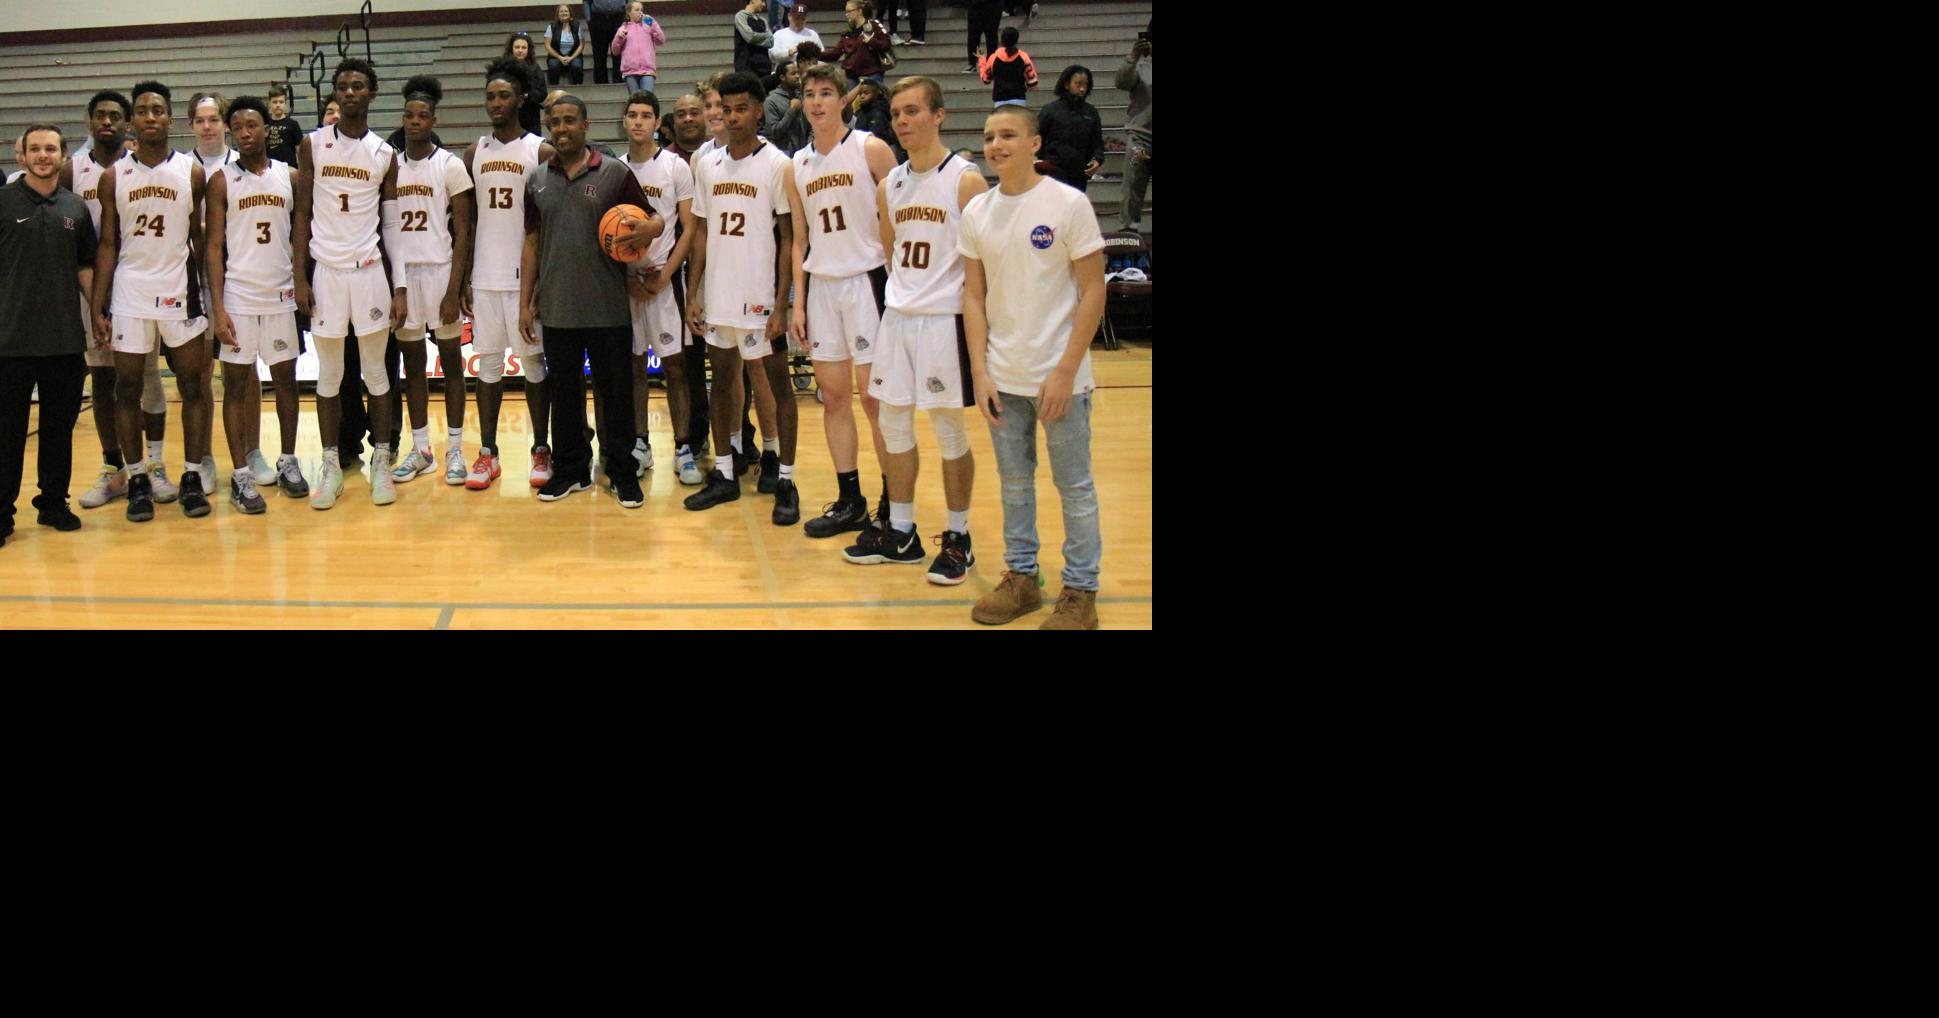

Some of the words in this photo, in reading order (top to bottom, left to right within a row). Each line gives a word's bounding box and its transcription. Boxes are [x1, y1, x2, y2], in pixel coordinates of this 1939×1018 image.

[322, 166, 371, 181] ROBINSON
[481, 161, 525, 175] ROBINSON
[584, 184, 597, 198] R
[713, 183, 758, 198] ROBINSON
[806, 173, 854, 197] ROBINSON
[129, 186, 178, 202] ROBINSON
[239, 194, 286, 210] ROBINSON
[488, 187, 513, 209] 13
[339, 194, 349, 212] 1
[64, 216, 74, 230] R
[401, 210, 428, 232] 22
[720, 212, 745, 236] 12
[819, 205, 847, 233] 11
[895, 207, 946, 224] ROBINSON
[133, 214, 165, 237] 24
[256, 222, 271, 244] 3
[1031, 234, 1053, 242] NASA
[901, 240, 930, 269] 10
